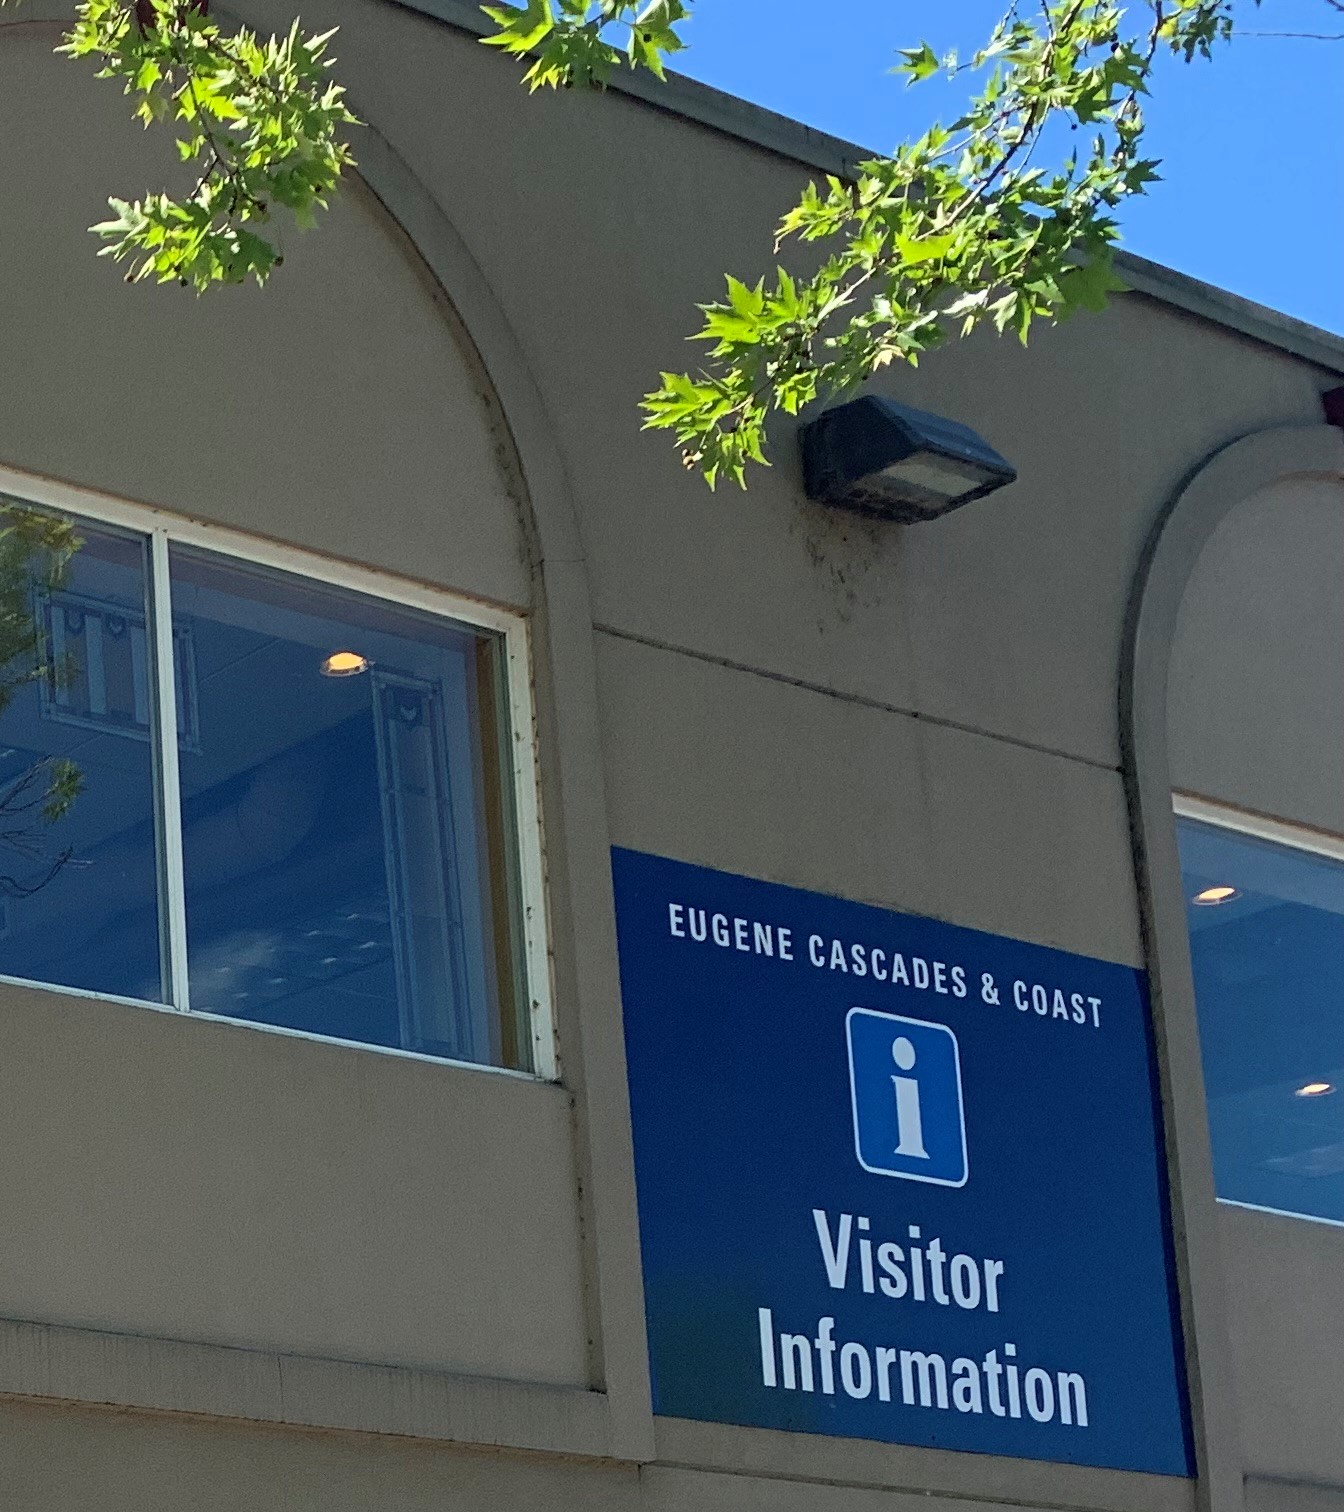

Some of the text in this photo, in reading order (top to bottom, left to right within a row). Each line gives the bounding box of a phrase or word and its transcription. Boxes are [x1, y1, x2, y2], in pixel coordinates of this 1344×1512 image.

[668, 903, 1103, 1028] EUGENE CASCADES & COAST
[812, 1209, 1004, 1313] Visitor
[757, 1307, 1089, 1427] Information
